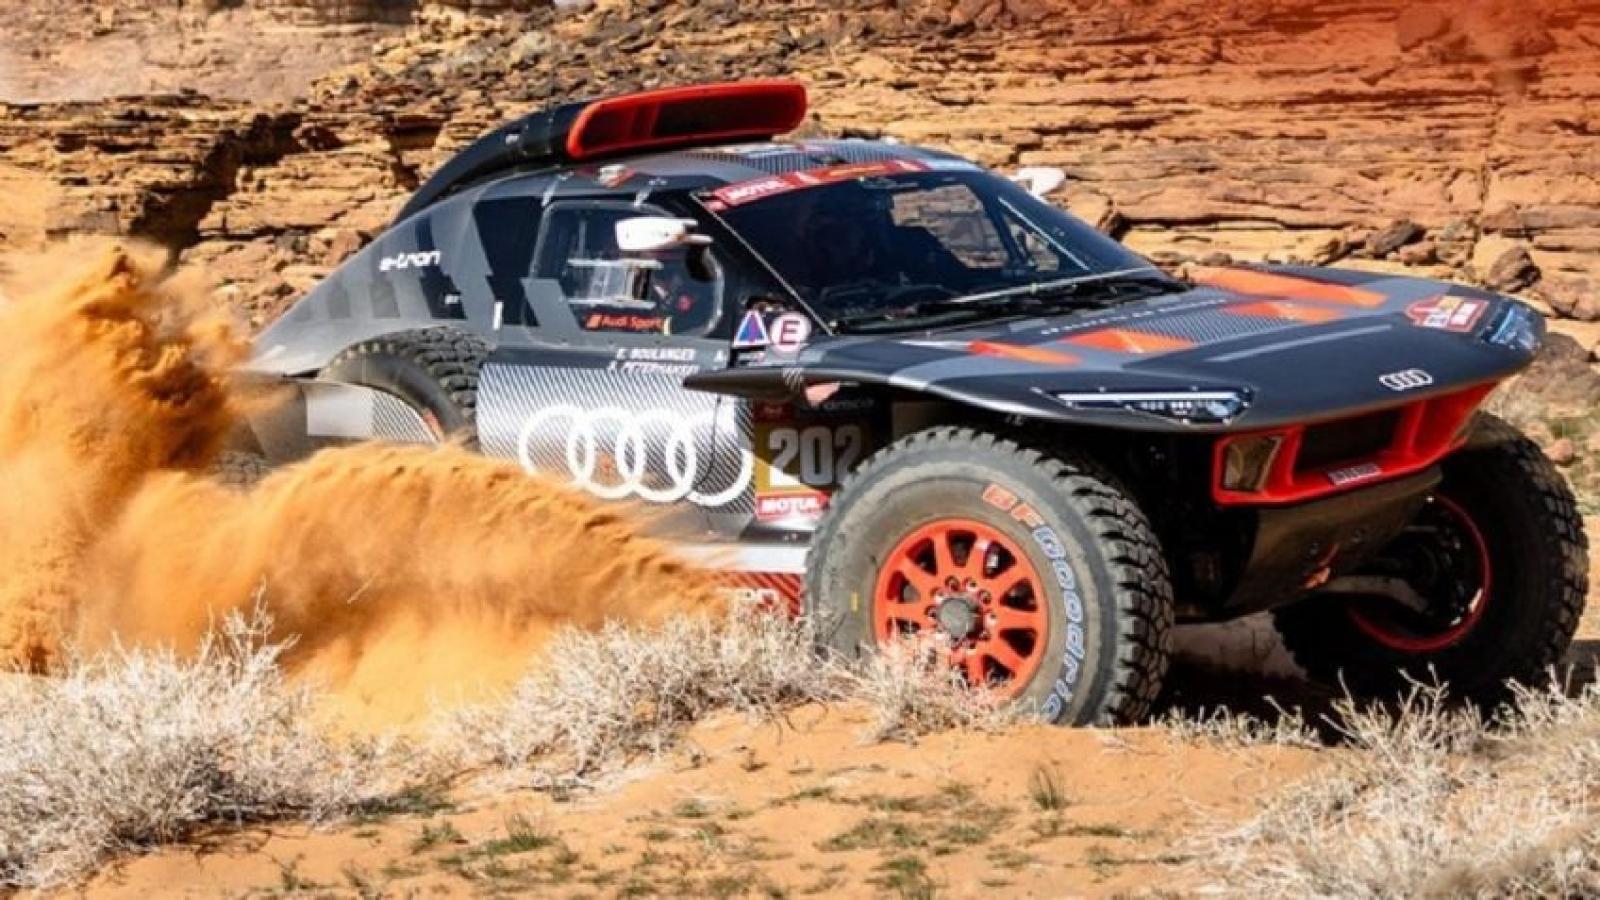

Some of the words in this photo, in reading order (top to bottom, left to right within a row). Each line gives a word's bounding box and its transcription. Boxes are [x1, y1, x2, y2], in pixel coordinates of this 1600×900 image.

[379, 249, 441, 271] e-tron
[602, 315, 628, 326] Audi
[780, 319, 800, 345] E
[630, 348, 695, 361] BOULANGER
[769, 424, 862, 487] 202
[760, 495, 821, 515] MOTUL
